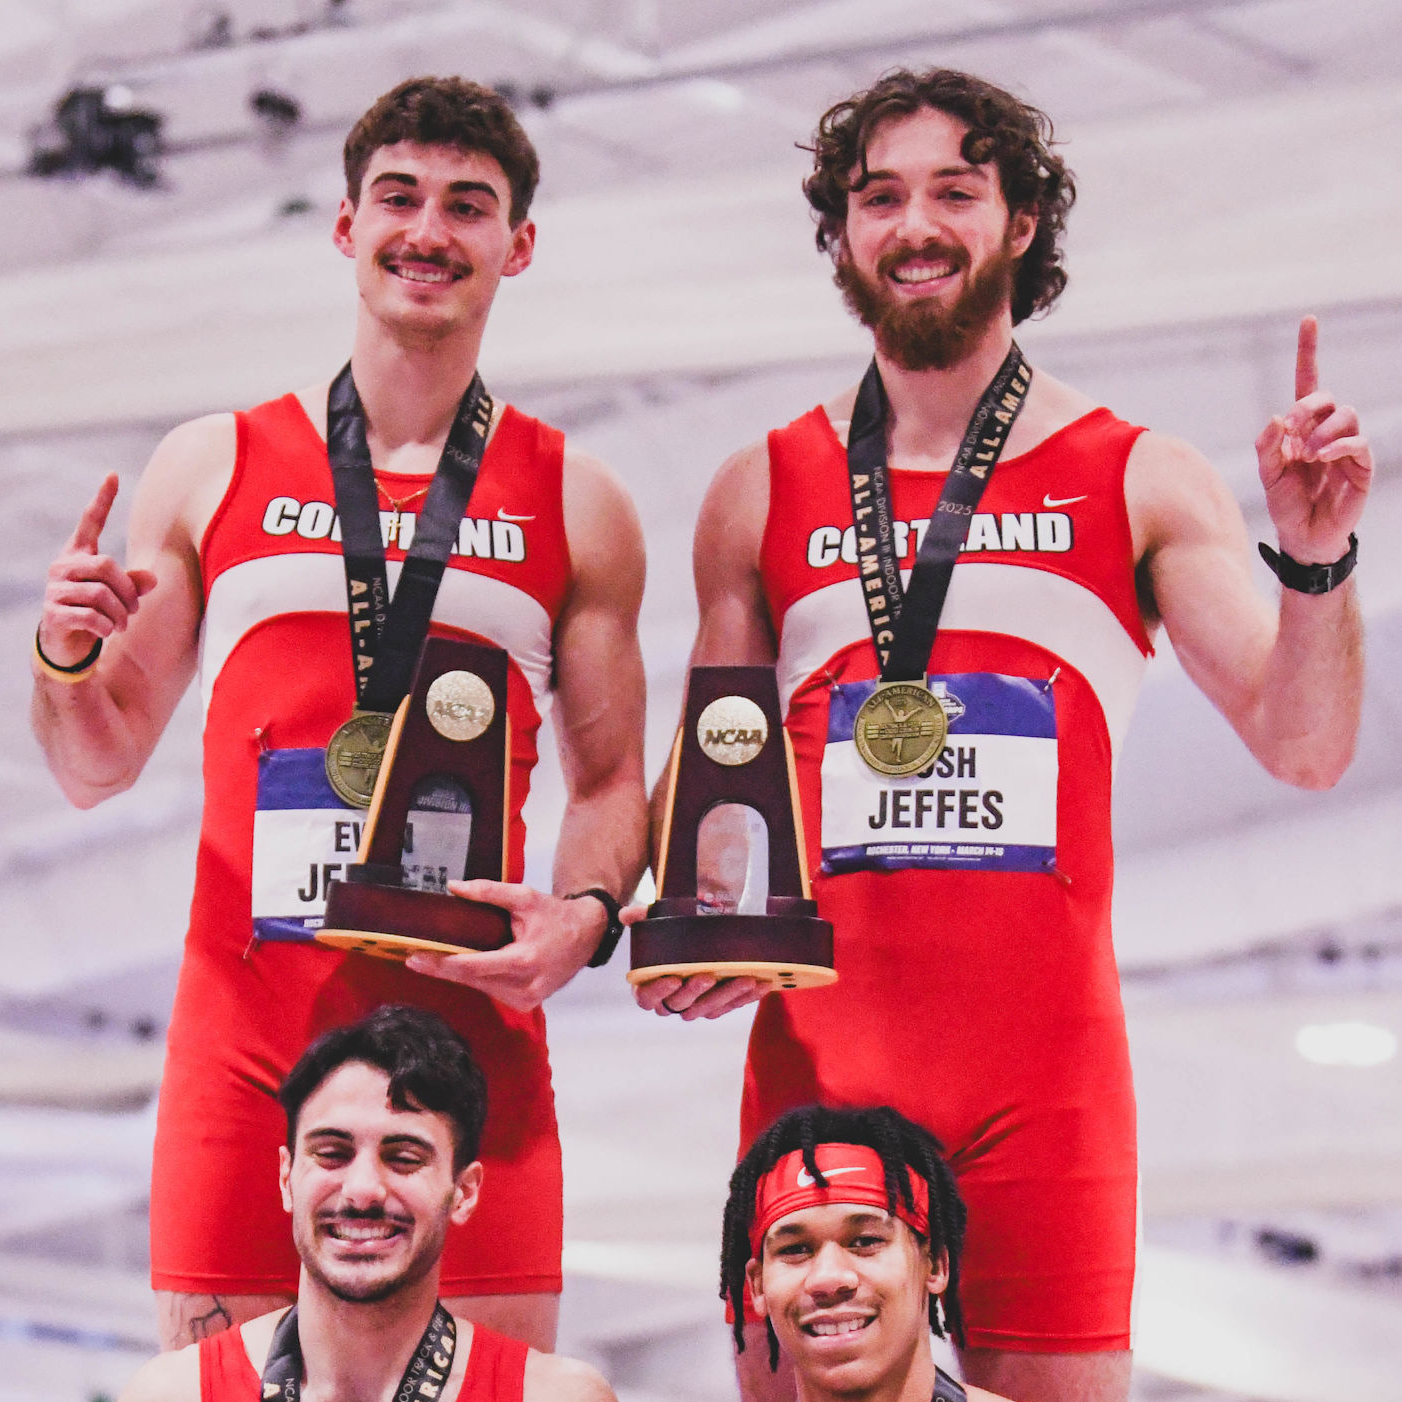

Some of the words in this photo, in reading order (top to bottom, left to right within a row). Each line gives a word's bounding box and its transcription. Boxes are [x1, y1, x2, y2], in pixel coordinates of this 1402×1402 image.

[876, 499, 891, 543] DIVISION
[937, 501, 972, 516] 2025
[883, 556, 901, 601] INDOOR
[704, 729, 764, 747] NCAA
[917, 746, 976, 778] SH
[869, 789, 1003, 830] JEFFES
[411, 1344, 433, 1377] TRACK
